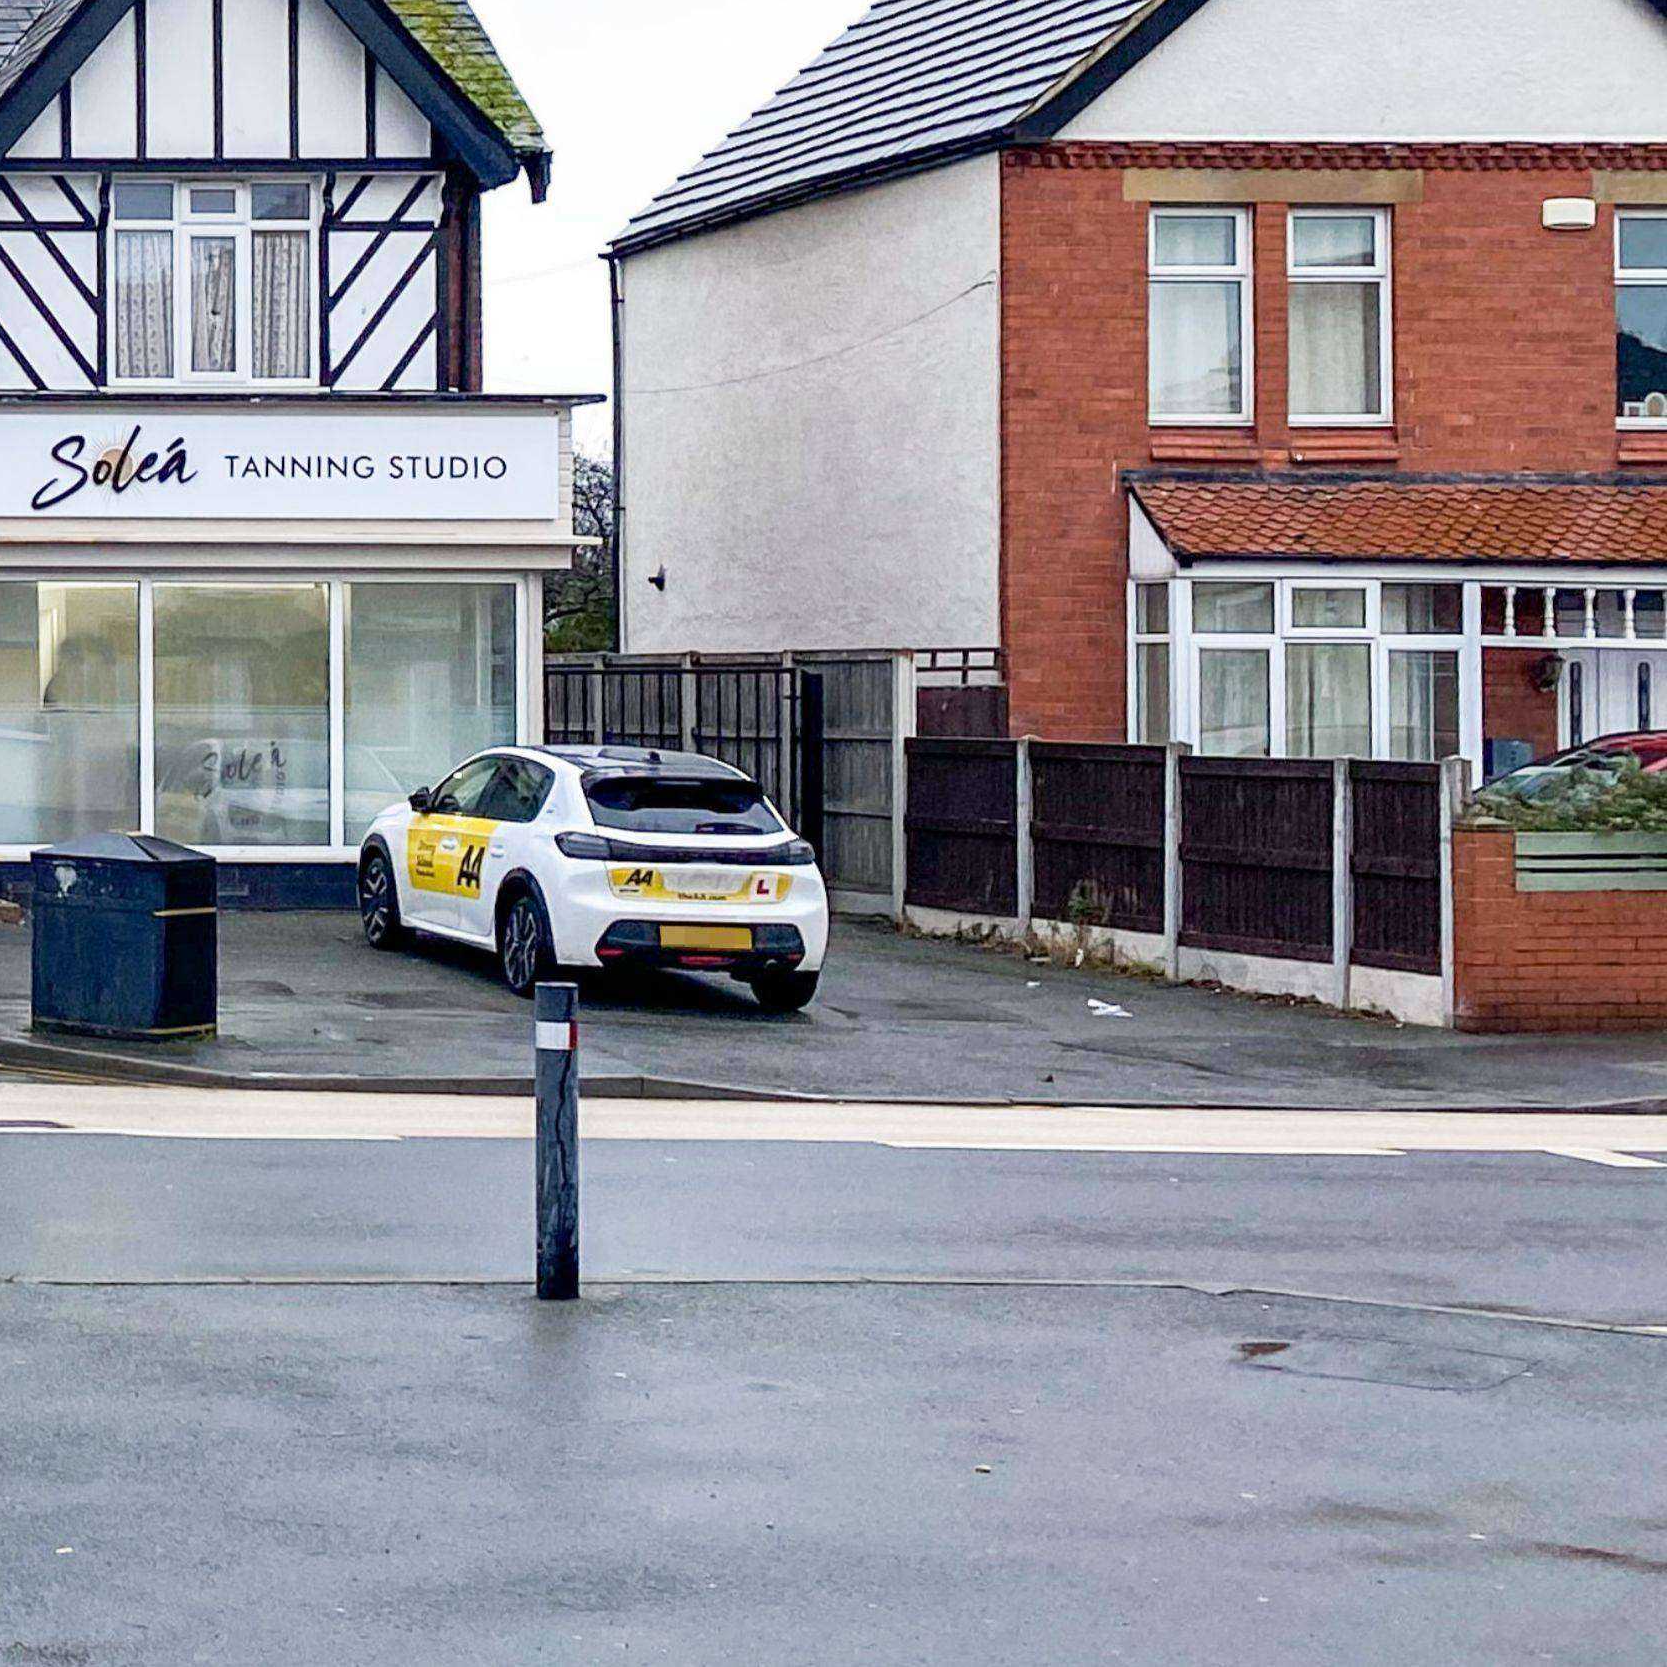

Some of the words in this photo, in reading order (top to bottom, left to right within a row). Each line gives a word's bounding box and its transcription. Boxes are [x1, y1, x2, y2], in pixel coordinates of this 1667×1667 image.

[31, 425, 199, 510] Soleá
[224, 455, 375, 479] TANNING
[389, 455, 507, 479] STUDIO
[457, 844, 486, 889] AA
[624, 868, 654, 886] AA
[756, 878, 770, 895] L
